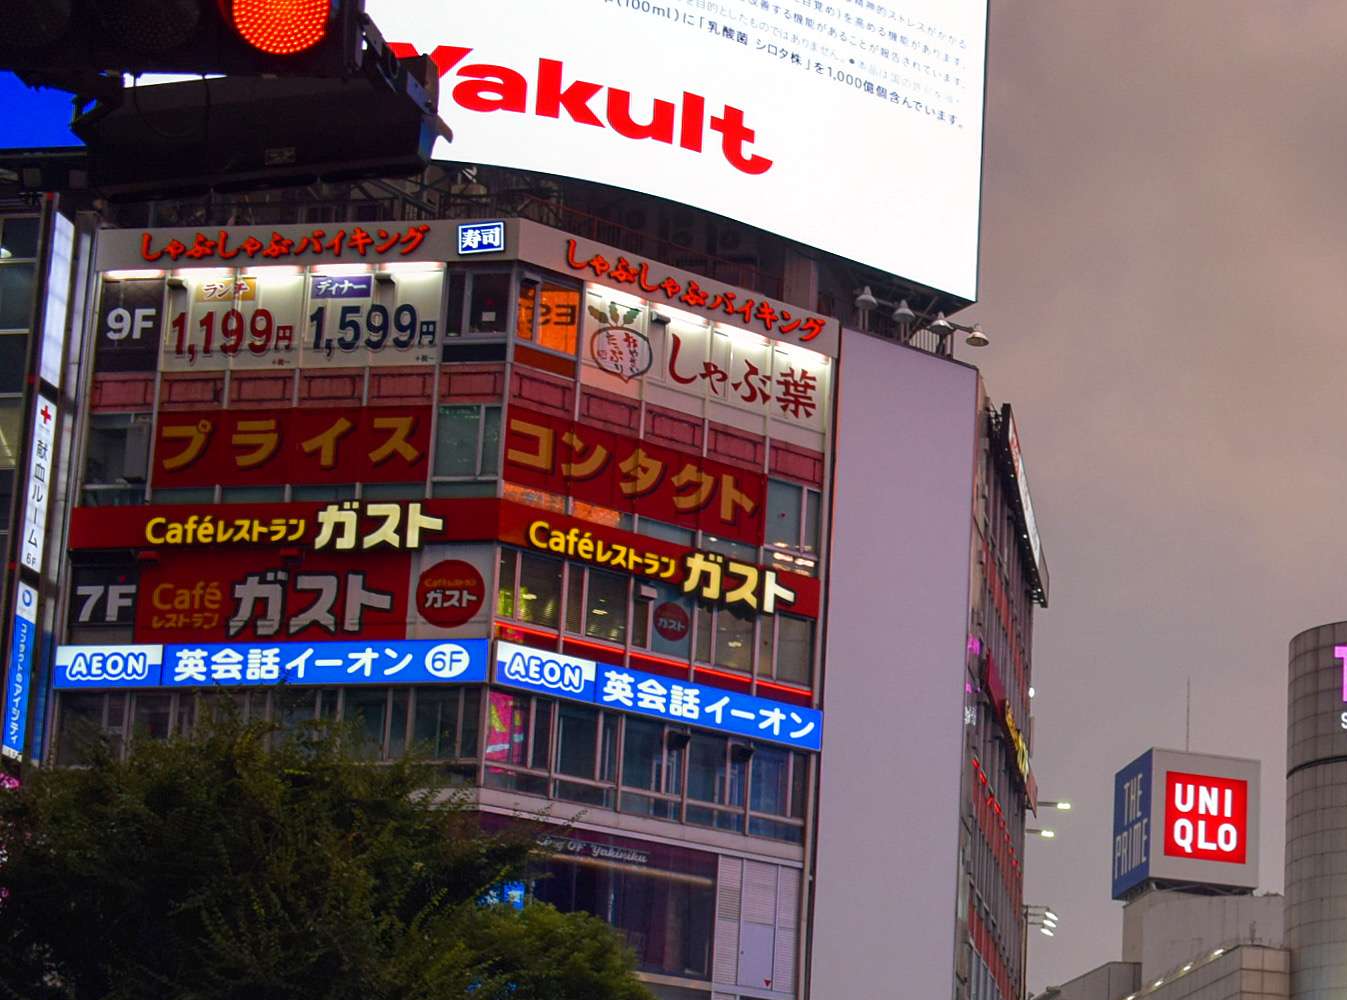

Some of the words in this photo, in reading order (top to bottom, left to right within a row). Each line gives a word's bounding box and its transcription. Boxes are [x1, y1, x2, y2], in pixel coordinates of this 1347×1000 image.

[390, 42, 773, 175] Yakult
[141, 224, 430, 261] しゃぶしゃぶバイキング
[461, 226, 501, 251] 寿司
[202, 281, 249, 300] ランチ
[315, 277, 369, 297] ディナー
[566, 238, 826, 341] しゃぶしゃぶバイキング
[106, 307, 157, 341] 9F
[171, 307, 294, 363] 1,199円
[309, 302, 437, 356] 1,599円
[668, 333, 817, 419] しゃぶ葉
[161, 415, 420, 470] プライス
[506, 418, 754, 521] コンタクト
[28, 440, 49, 549] 献血ルーム
[313, 503, 443, 549] ガスト
[152, 582, 222, 610] Café
[424, 589, 478, 608] ガスト
[683, 552, 795, 613] ガスト
[76, 585, 137, 623] 7F
[151, 613, 219, 629] レストラン
[227, 570, 392, 637] ガスト
[657, 616, 686, 634] ガスト
[68, 652, 148, 679] AEON
[174, 648, 413, 682] 英会話イーオン
[430, 649, 467, 673] 6F
[508, 655, 583, 691] AEON
[602, 669, 816, 739] 英会話イーオン
[1123, 772, 1144, 820] THE
[1174, 782, 1233, 818] UNI
[1114, 817, 1149, 880] PRIME
[1173, 817, 1238, 854] QLO
